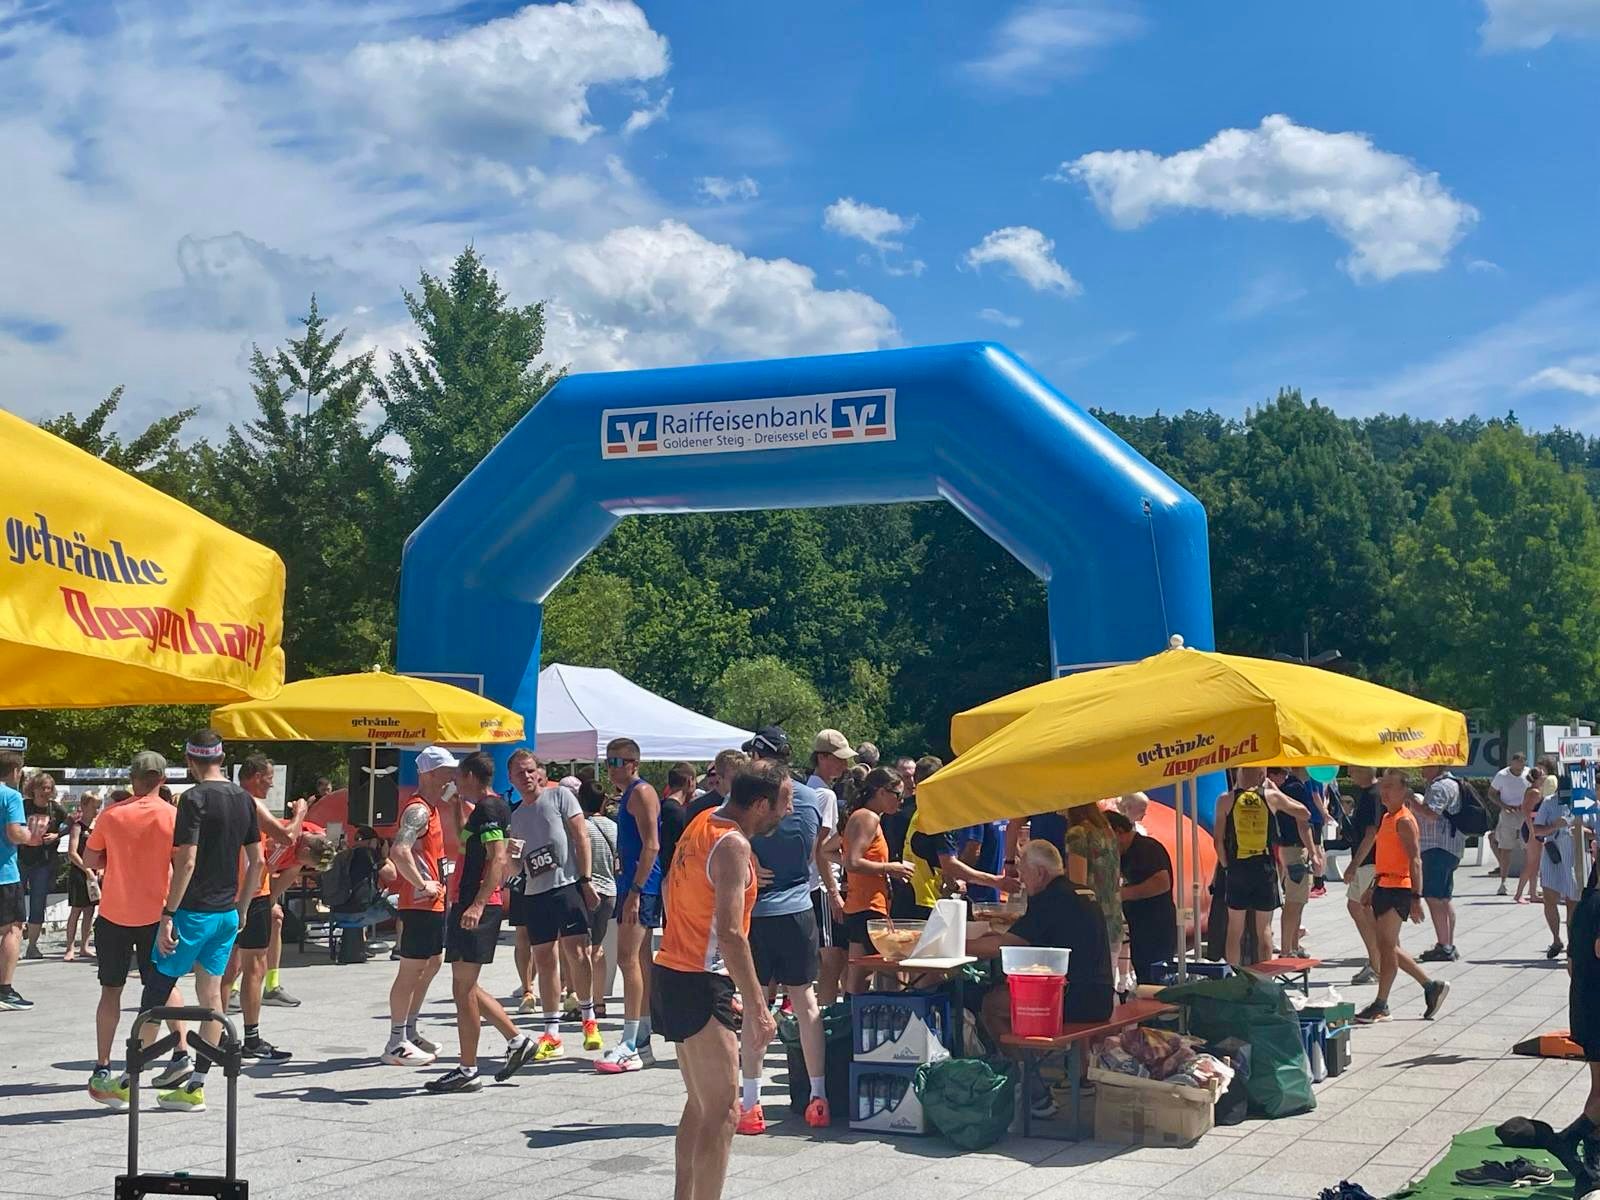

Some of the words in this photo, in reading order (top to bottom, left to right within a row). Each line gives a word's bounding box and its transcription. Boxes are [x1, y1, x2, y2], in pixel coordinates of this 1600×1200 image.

[662, 402, 828, 434] Raiffeisenbank
[663, 436, 713, 449] Goldener
[716, 434, 745, 448] Steig
[754, 428, 809, 444] Dreisessel
[812, 428, 828, 440] eG
[5, 512, 168, 585] getränke
[59, 585, 267, 672] Degenhart
[351, 716, 401, 728] getränke
[1136, 733, 1216, 767] getränke
[1570, 770, 1587, 789] WC
[530, 852, 553, 870] 305
